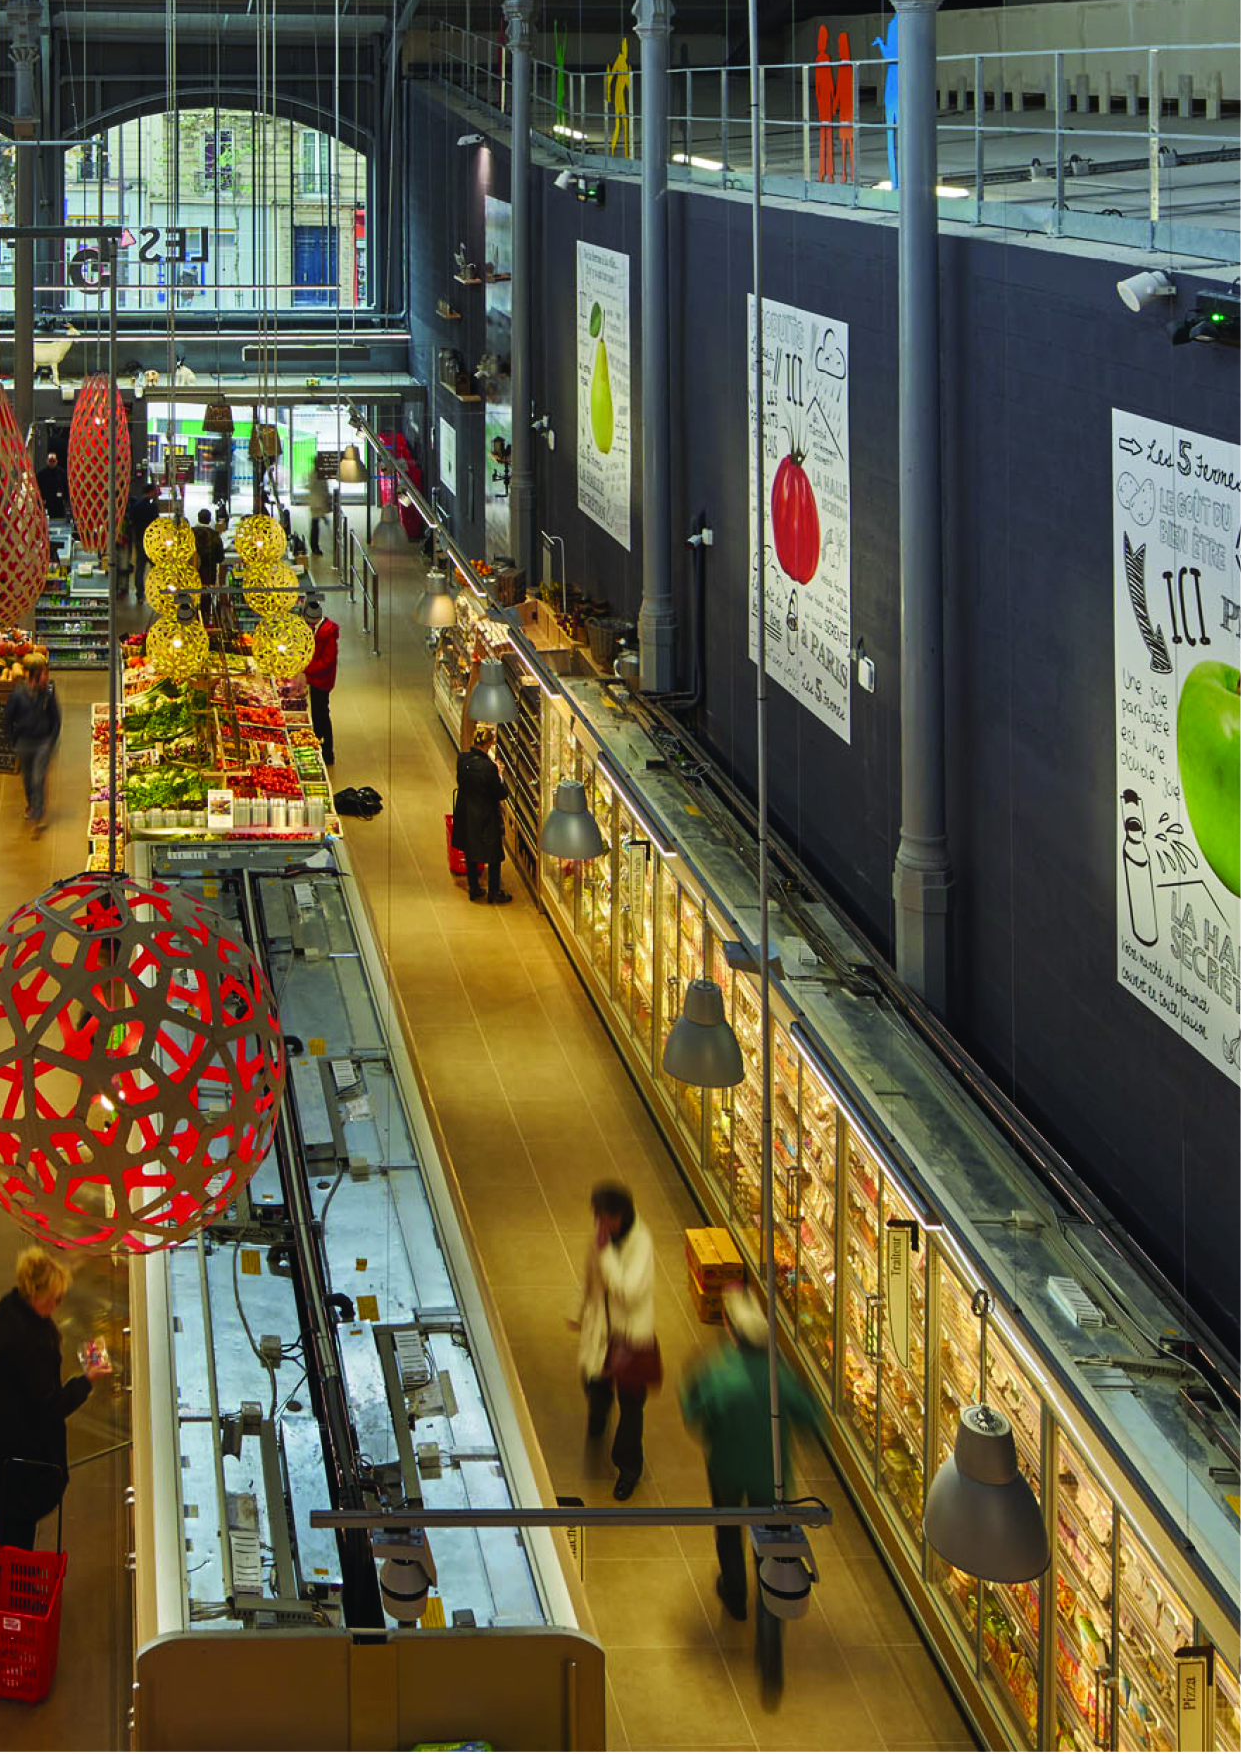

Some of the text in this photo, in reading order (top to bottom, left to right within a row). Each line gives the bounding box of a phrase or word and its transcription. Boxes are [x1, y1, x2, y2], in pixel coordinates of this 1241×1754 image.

[785, 352, 803, 407] ICI
[1177, 439, 1193, 477] 5
[1162, 566, 1212, 647] ICI
[810, 630, 849, 690] PARIS
[814, 676, 823, 703] 5
[1145, 738, 1166, 765] une
[1170, 889, 1198, 942] LA
[891, 1236, 902, 1276] Traiteur
[1183, 1677, 1196, 1710] Pizza
